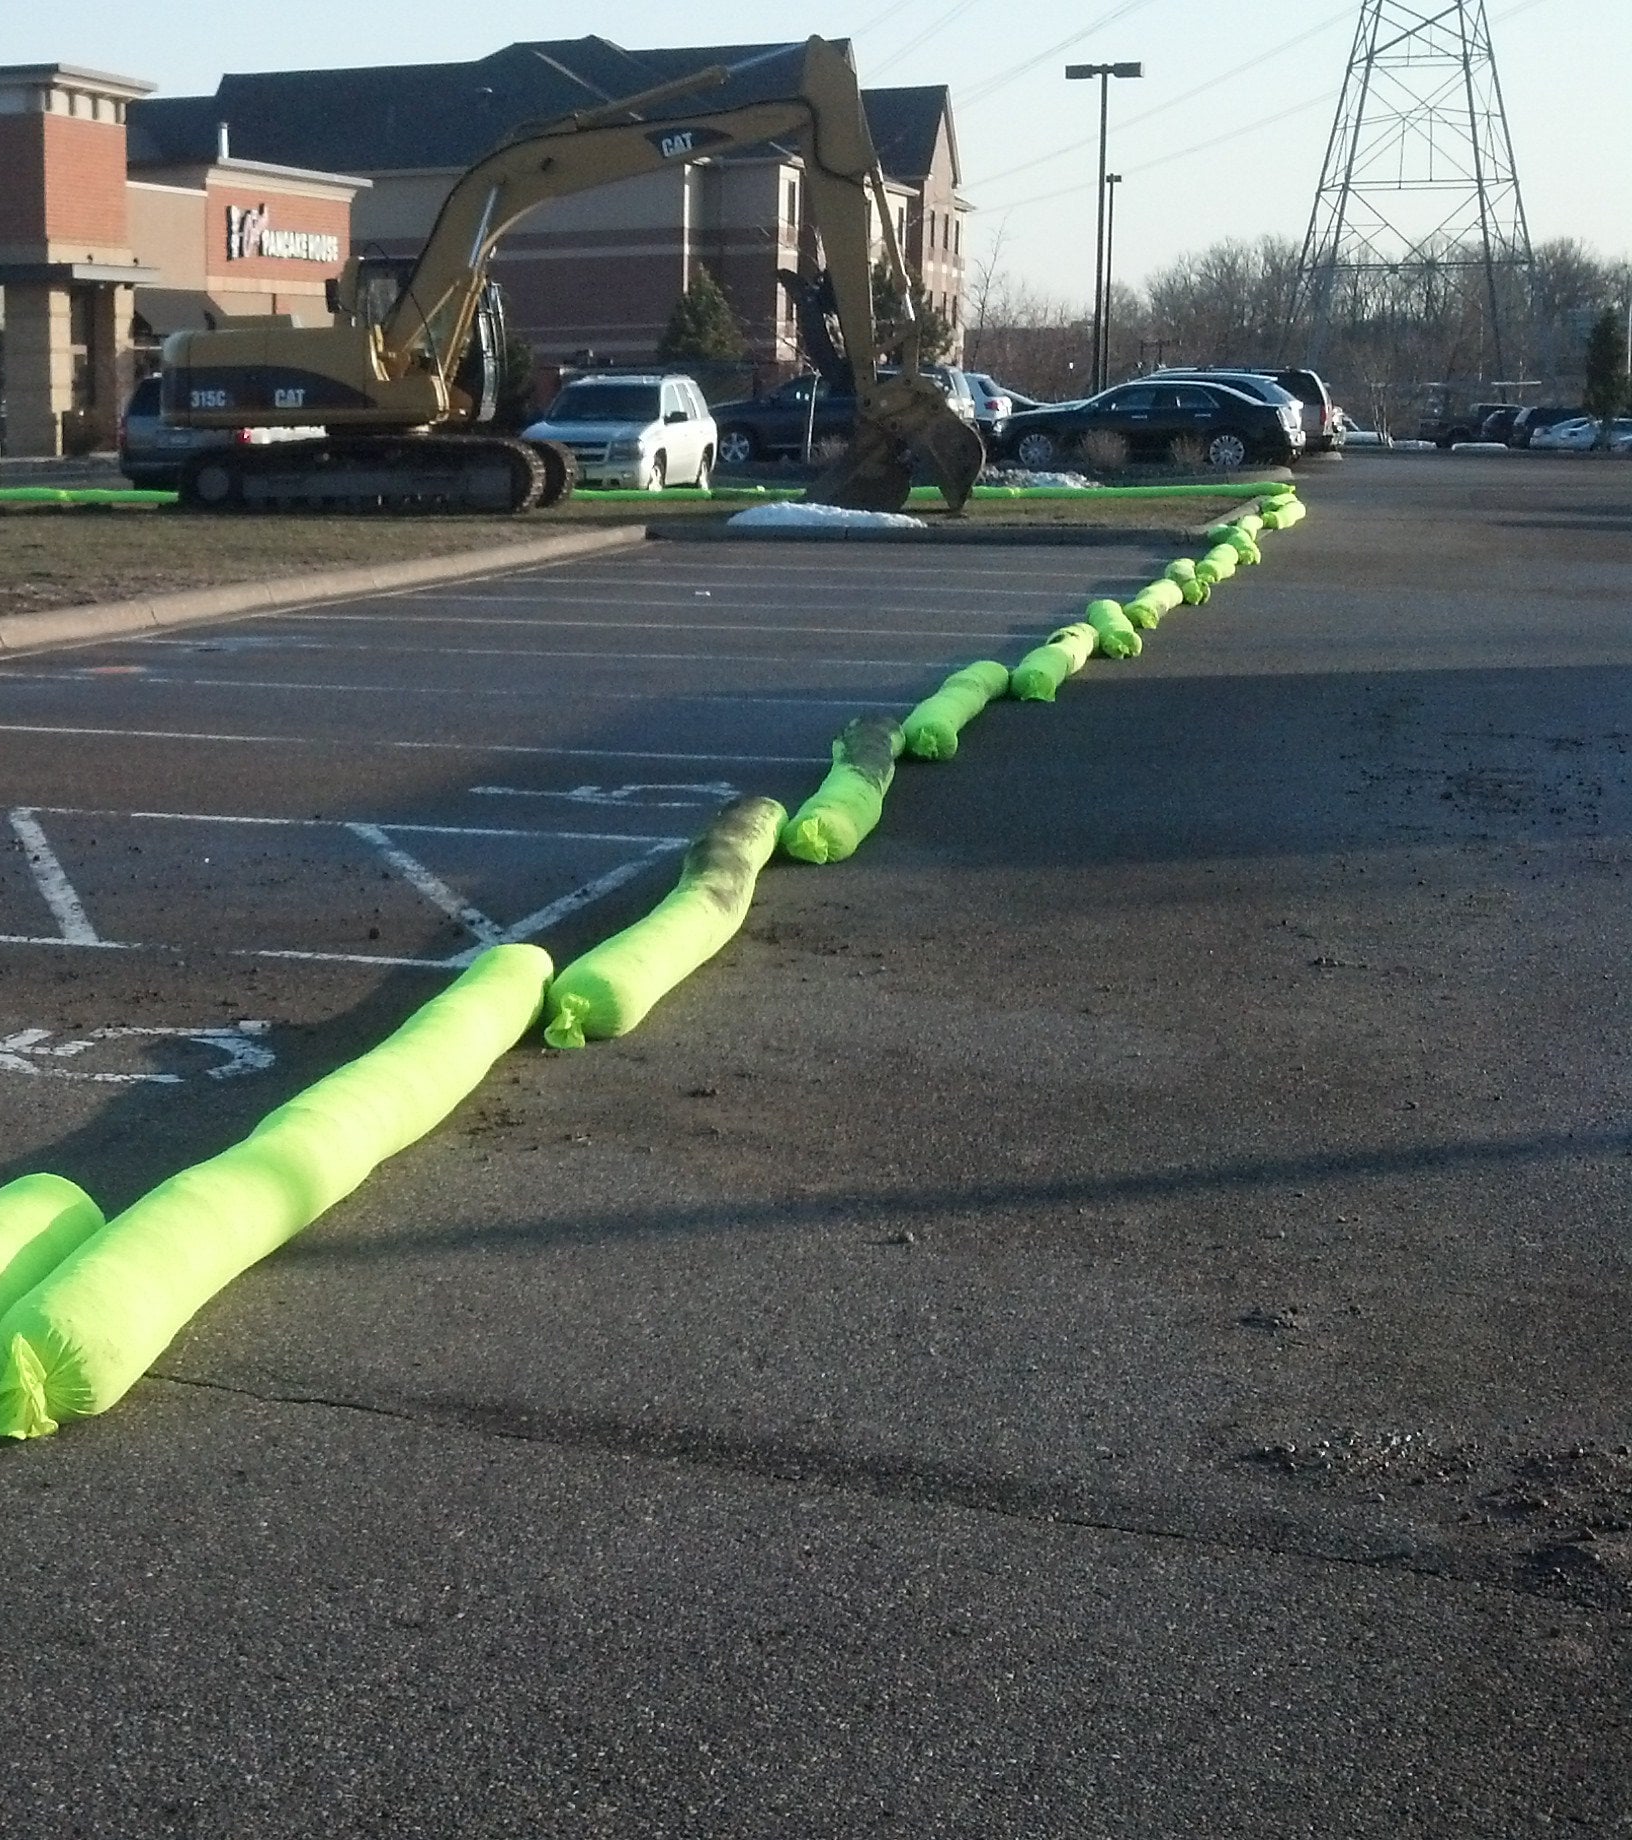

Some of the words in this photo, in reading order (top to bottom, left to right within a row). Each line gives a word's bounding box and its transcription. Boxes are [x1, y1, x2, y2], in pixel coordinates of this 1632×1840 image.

[662, 132, 692, 157] CAT
[190, 390, 226, 408] 315C
[274, 388, 306, 408] CAT
